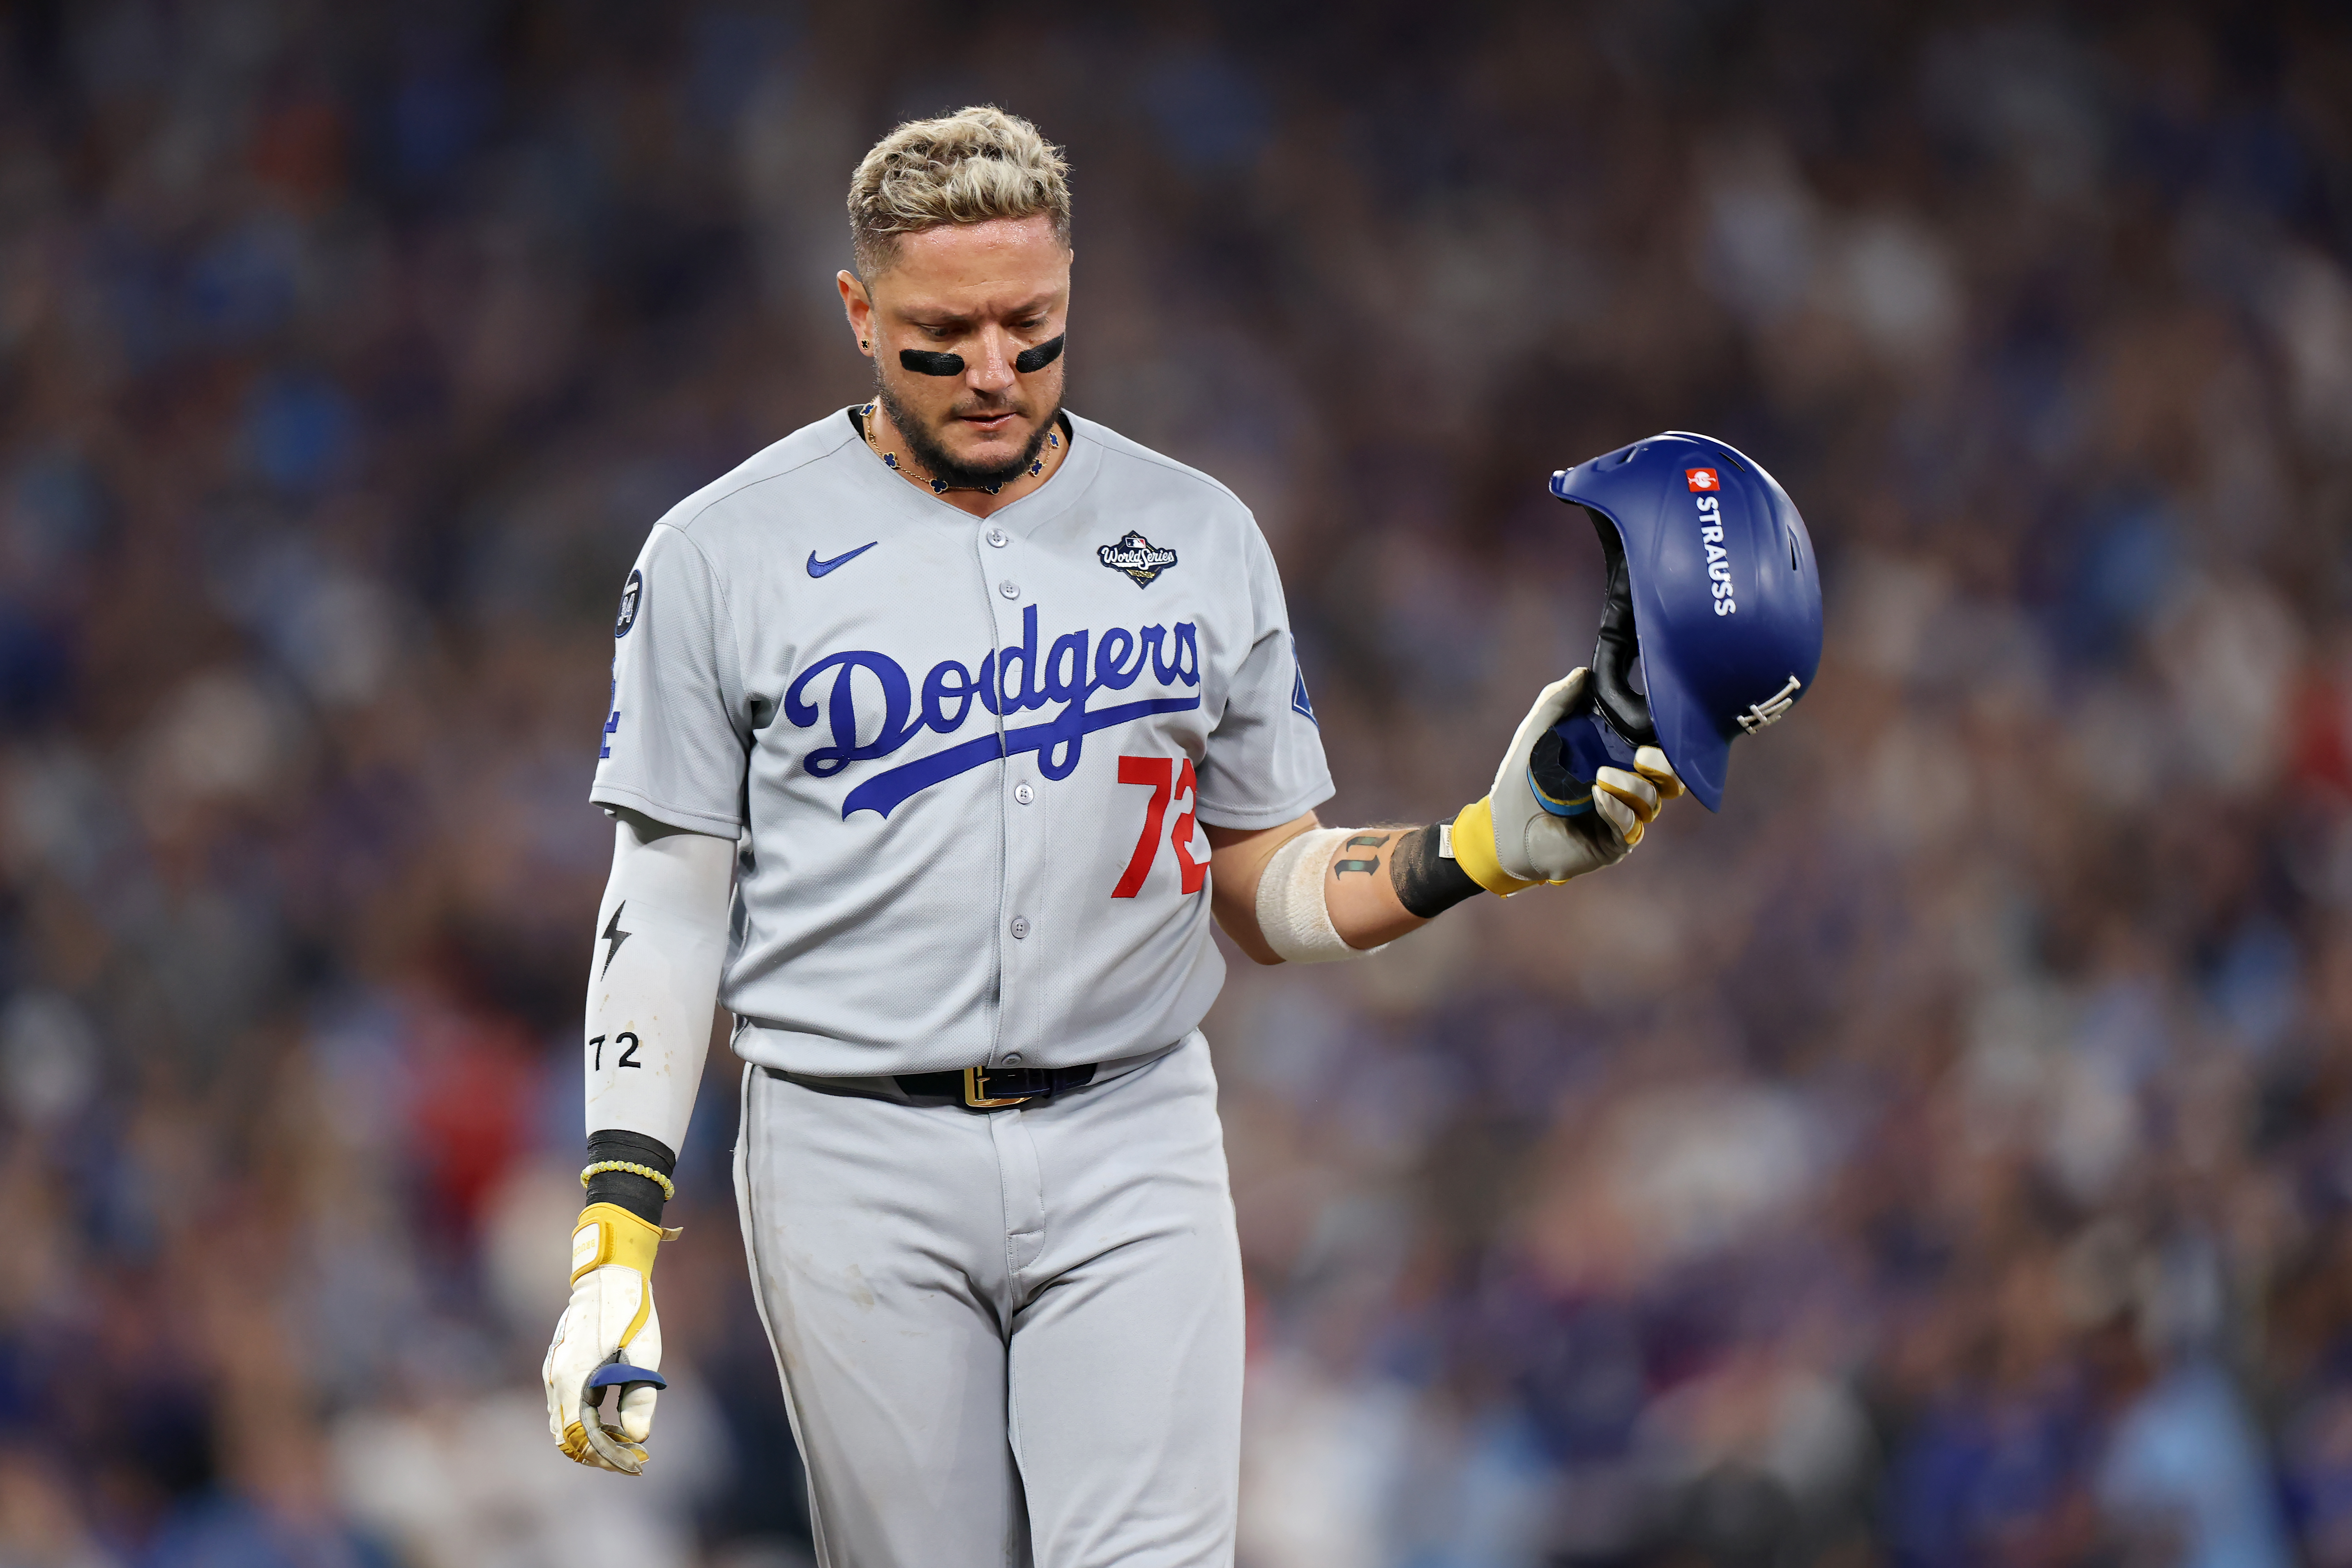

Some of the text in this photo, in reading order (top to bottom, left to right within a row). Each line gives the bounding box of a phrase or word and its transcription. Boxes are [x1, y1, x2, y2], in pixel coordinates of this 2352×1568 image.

[1101, 547, 1175, 570] World Series
[1695, 496, 1736, 616] STRAUSS
[784, 603, 1200, 780] Dodgers
[1111, 755, 1211, 898] 72
[589, 1032, 641, 1071] 72
